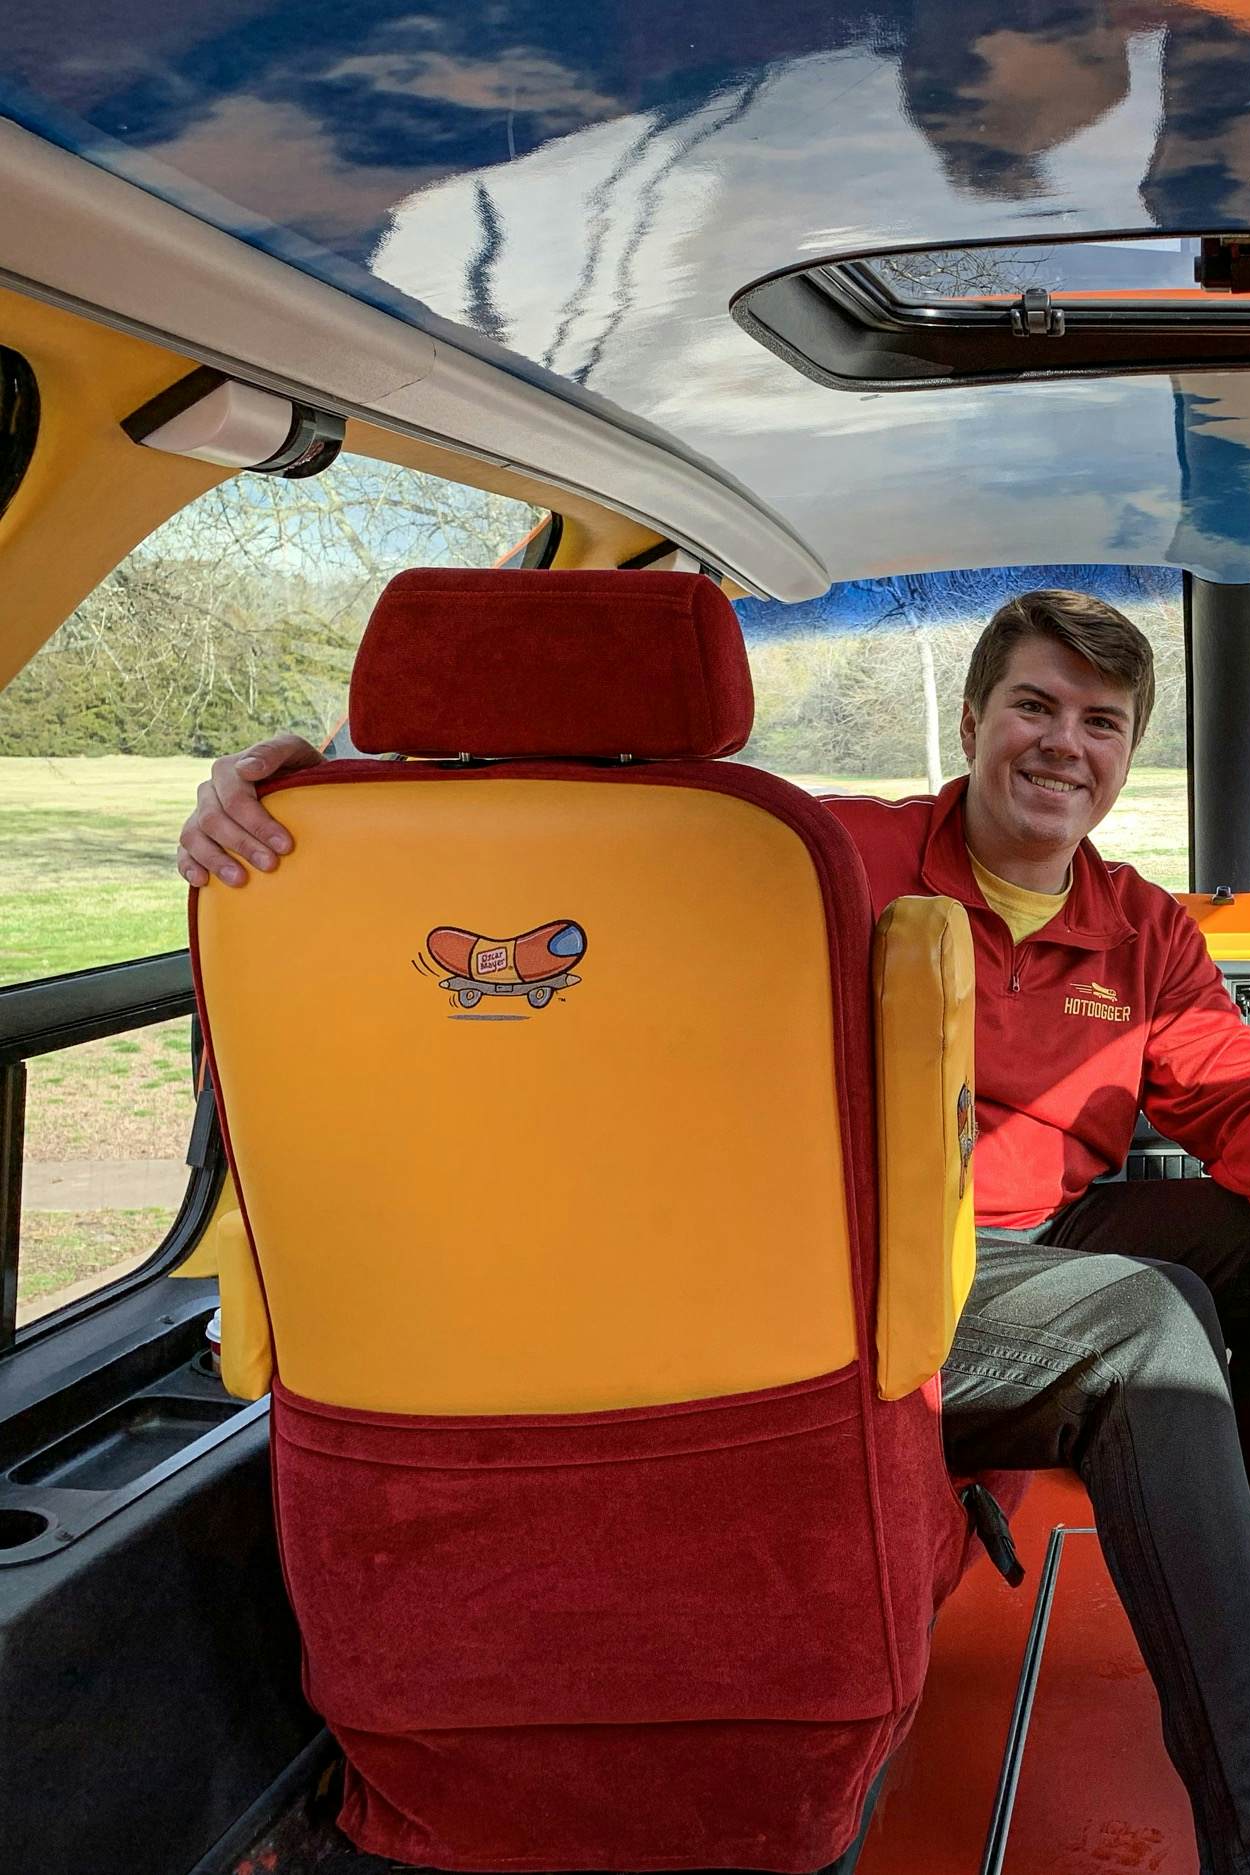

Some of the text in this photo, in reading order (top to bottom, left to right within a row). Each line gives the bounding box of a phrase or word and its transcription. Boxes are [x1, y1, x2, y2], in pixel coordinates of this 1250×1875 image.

[481, 952, 503, 963] Oscar
[480, 958, 505, 971] Mayer
[1064, 997, 1131, 1022] HOTDOGGER
